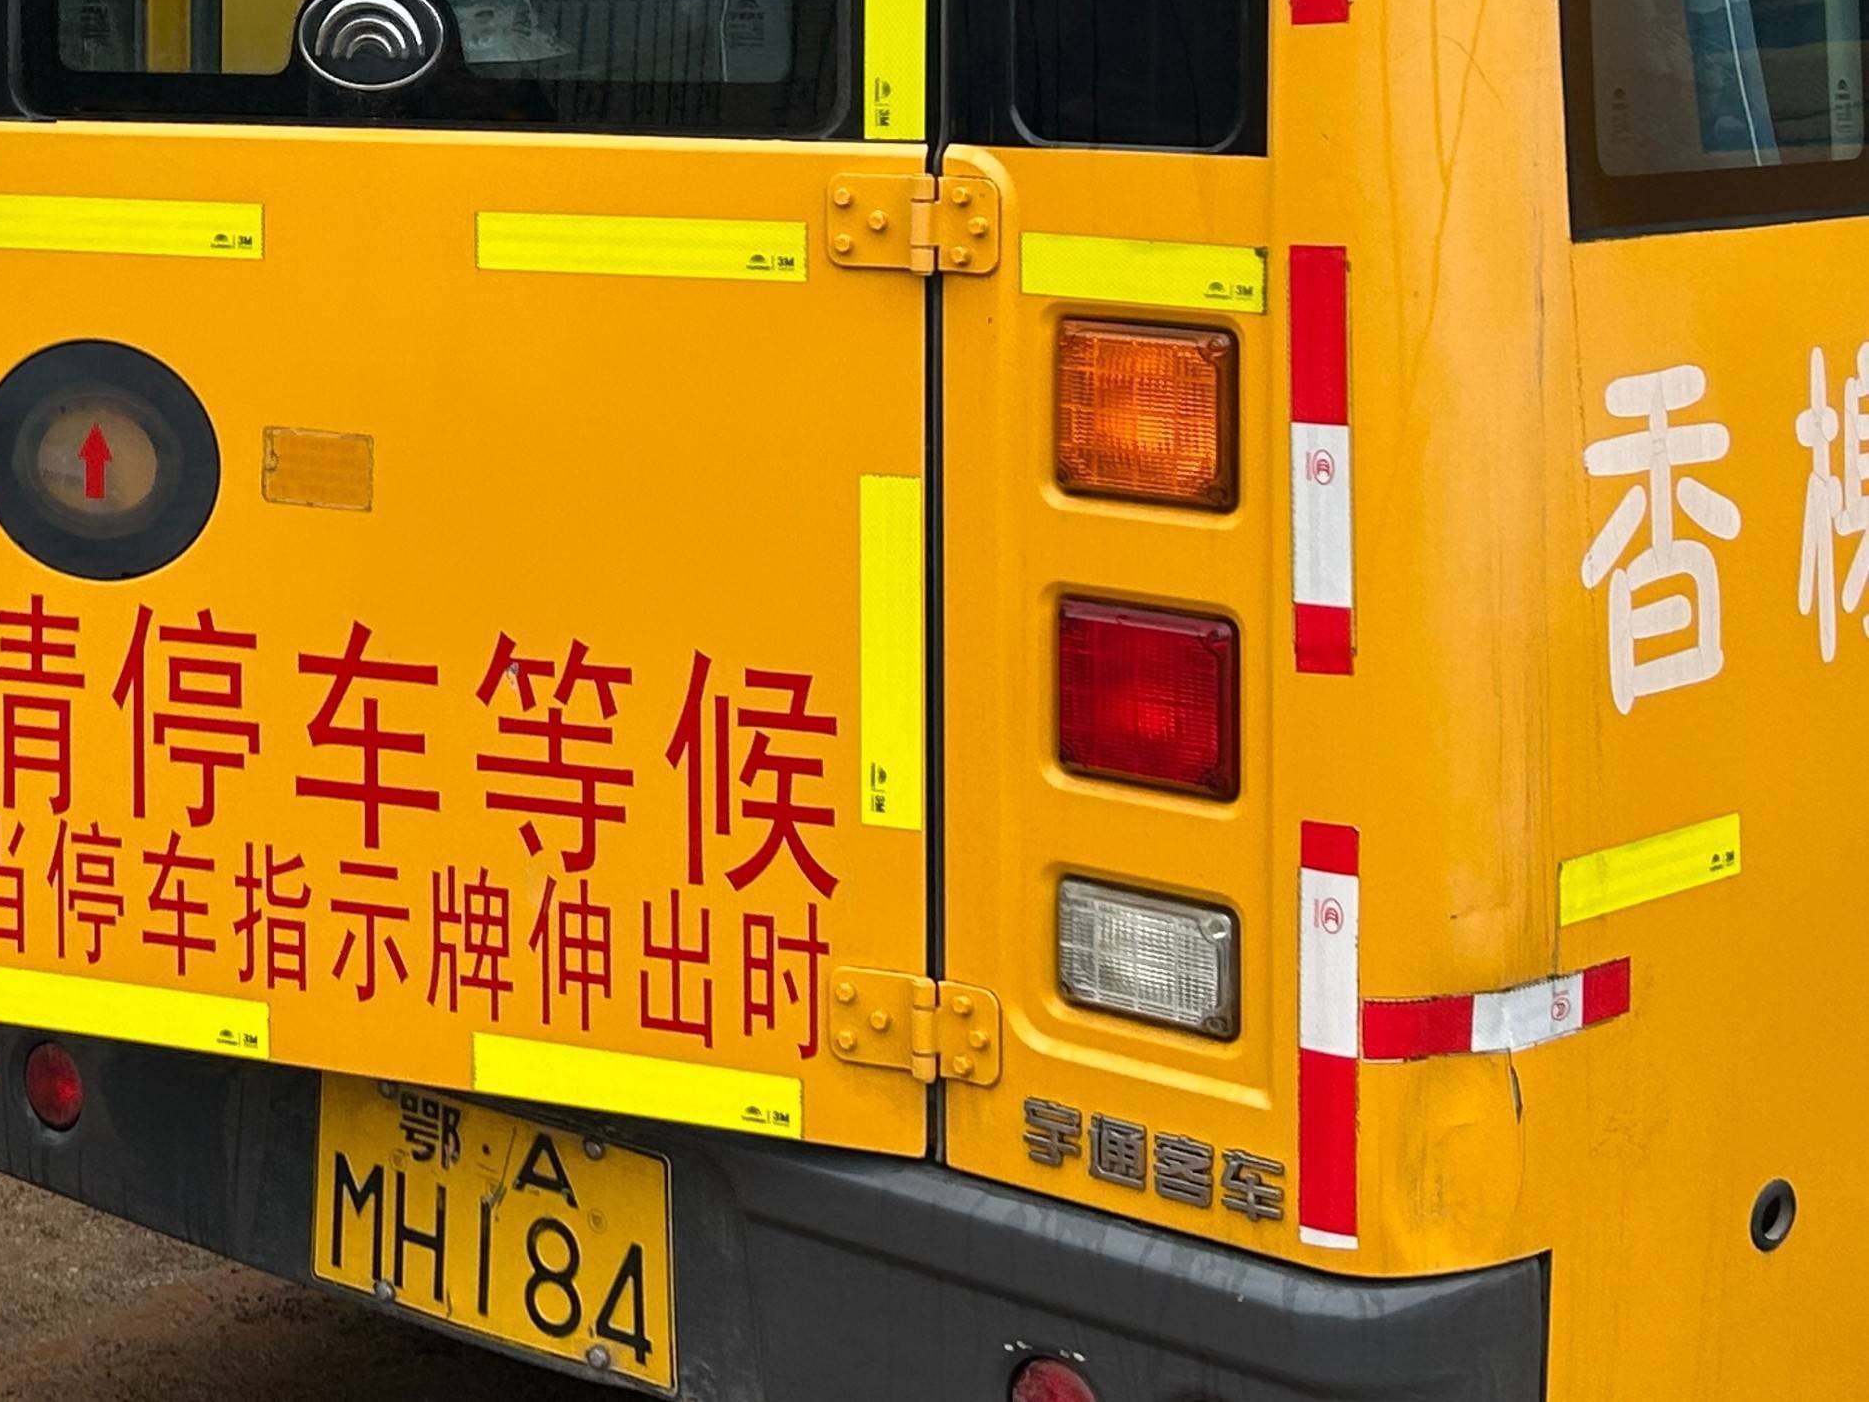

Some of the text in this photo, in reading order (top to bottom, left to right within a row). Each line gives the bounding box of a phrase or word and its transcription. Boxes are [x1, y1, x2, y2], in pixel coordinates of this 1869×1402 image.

[1023, 1096, 1286, 1222] 宇通客车
[331, 1151, 653, 1366] MH184
